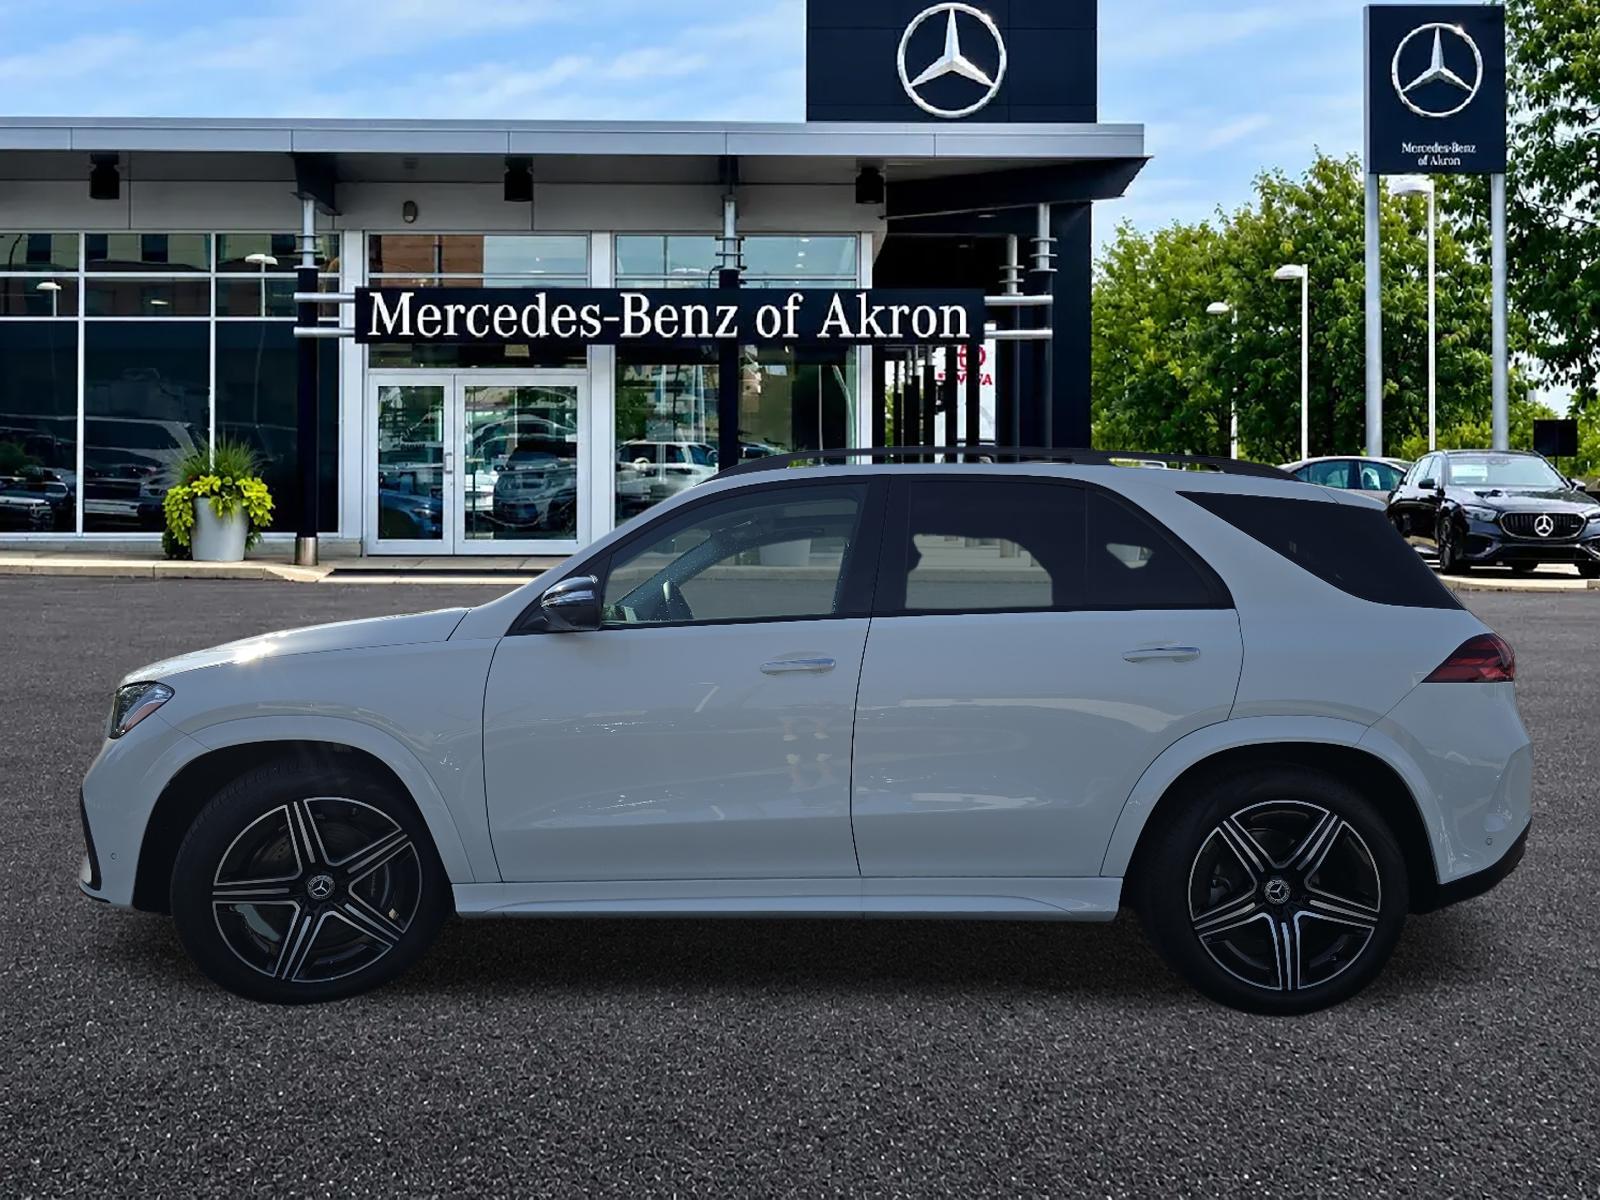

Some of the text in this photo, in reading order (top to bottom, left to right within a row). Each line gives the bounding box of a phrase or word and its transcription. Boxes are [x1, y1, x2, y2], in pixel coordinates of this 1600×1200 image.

[1401, 141, 1477, 153] Mercedes-Benz
[1417, 154, 1461, 166] of Akron
[366, 291, 971, 338] Mercedes-Benz of Akron
